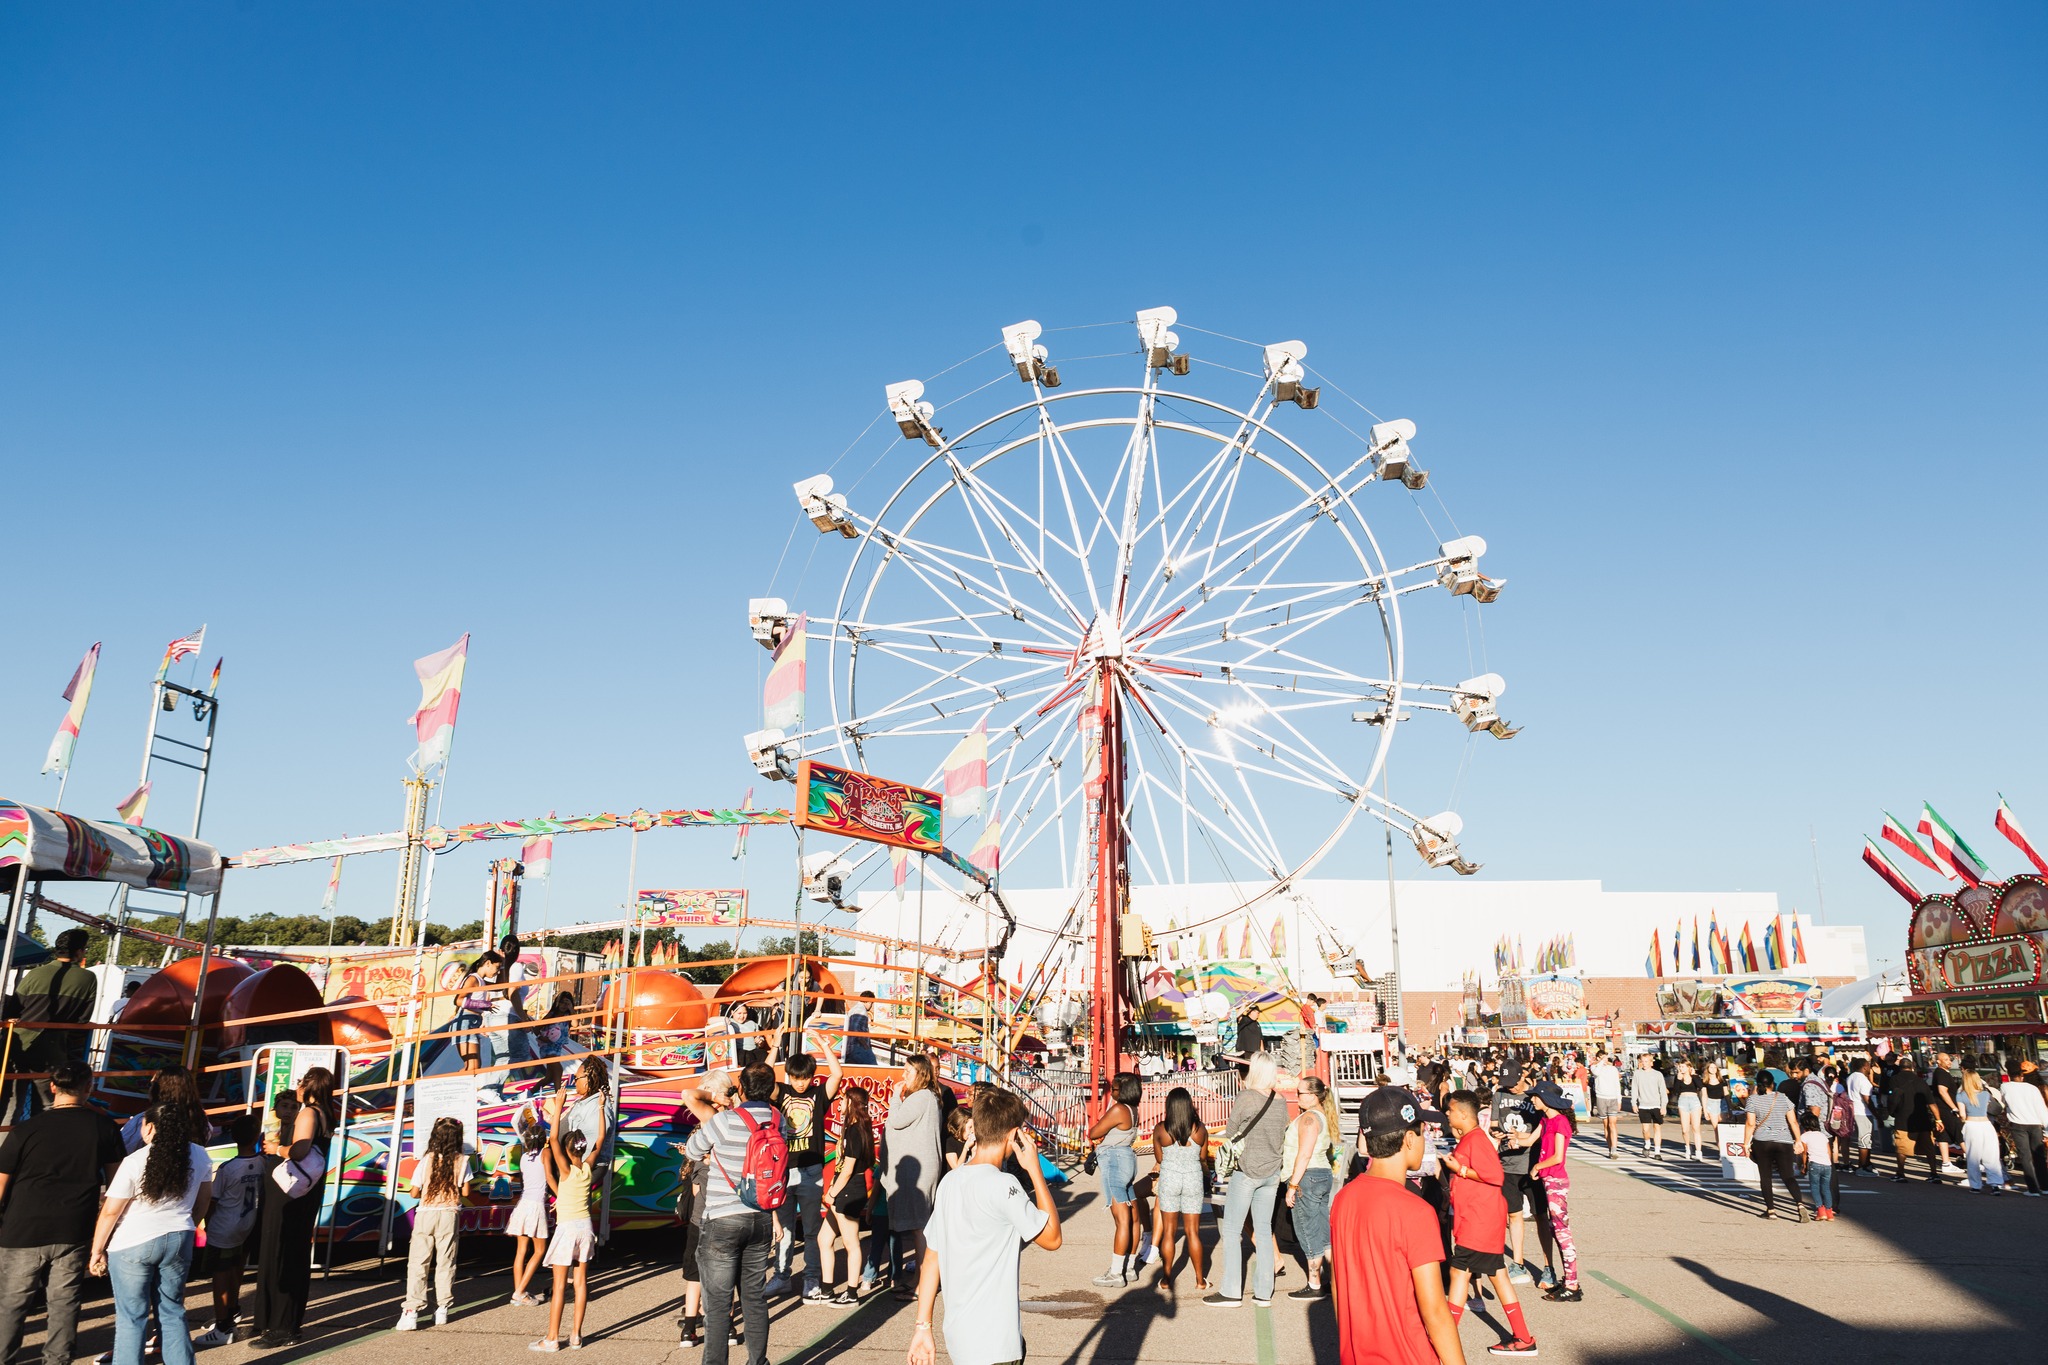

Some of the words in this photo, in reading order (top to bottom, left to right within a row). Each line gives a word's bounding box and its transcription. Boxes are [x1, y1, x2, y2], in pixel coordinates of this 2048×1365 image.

[840, 782, 902, 818] ARNOLD
[676, 914, 706, 922] WHIRL
[1948, 944, 2030, 984] PIZZA
[1541, 994, 1570, 1003] EARS
[1872, 1010, 1926, 1026] NACHOS
[1950, 1003, 2026, 1020] PRETZELS
[667, 1053, 690, 1061] WHIRL
[1499, 1098, 1536, 1114] CLASSIC
